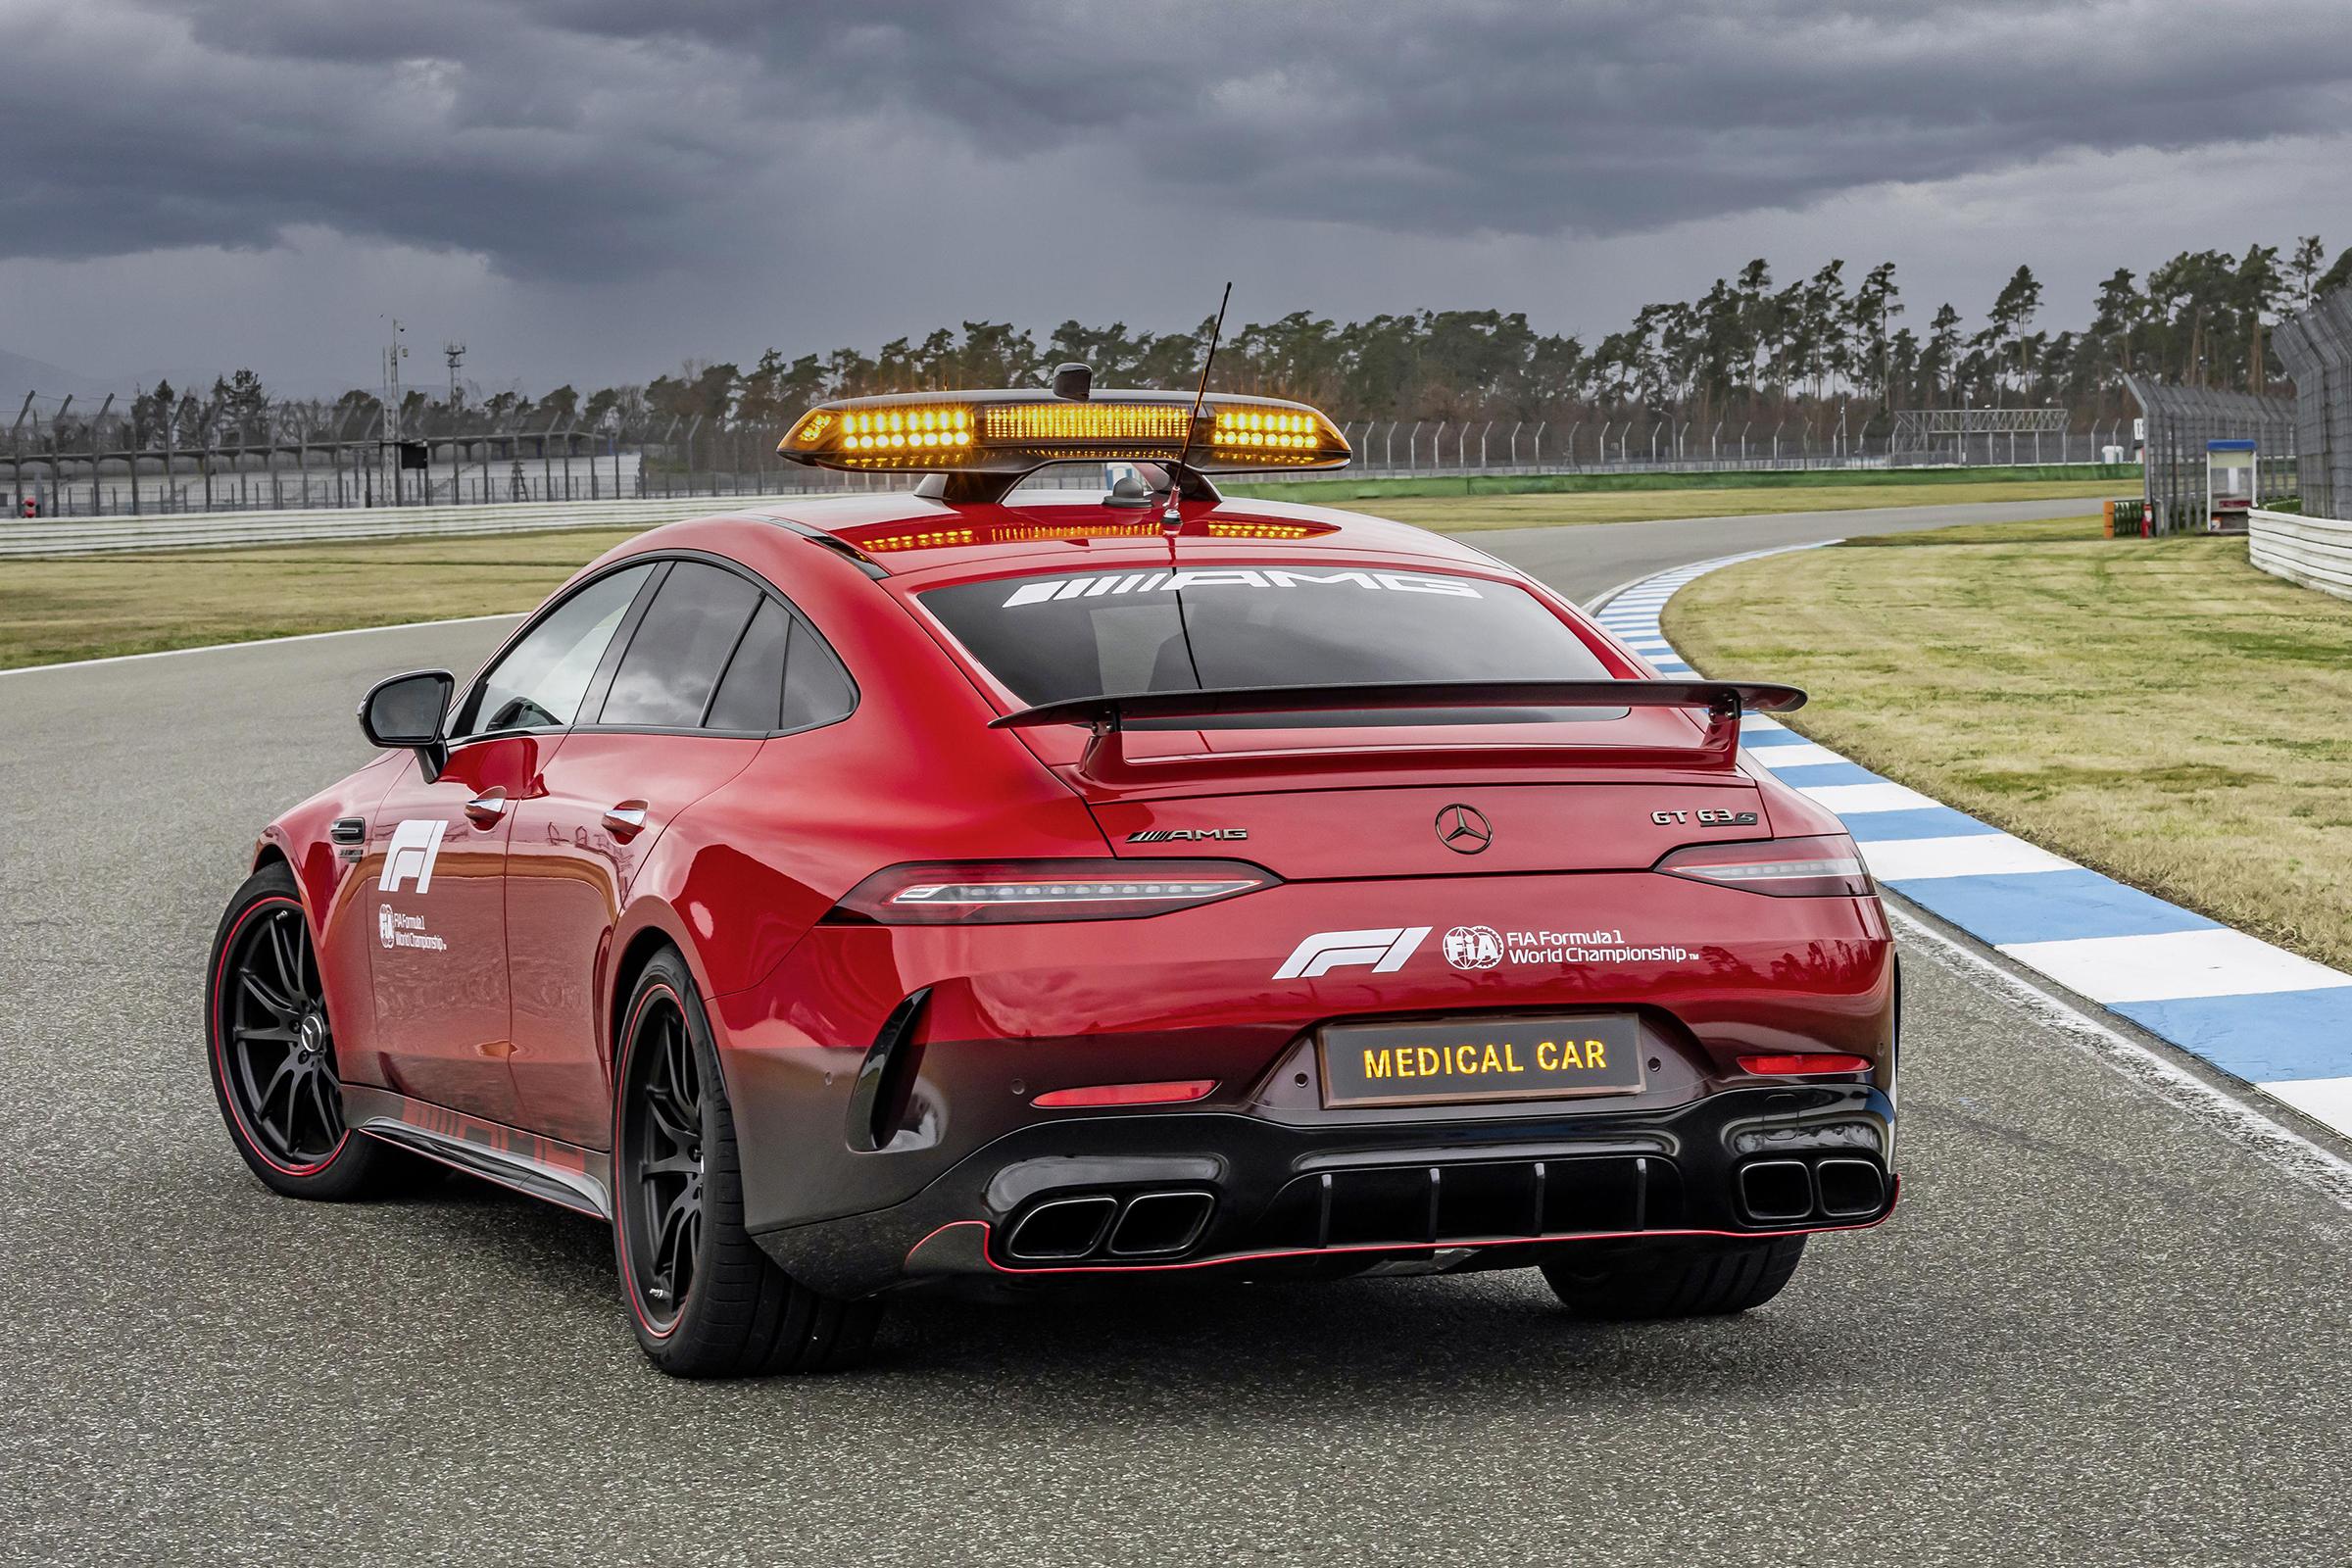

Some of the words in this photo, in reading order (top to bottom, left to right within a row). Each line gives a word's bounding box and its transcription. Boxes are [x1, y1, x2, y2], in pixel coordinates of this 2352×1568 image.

[1162, 569, 1484, 599] AMG
[1650, 810, 1688, 825] GT
[1165, 828, 1249, 842] AMG
[378, 819, 449, 894] F1
[1505, 931, 1539, 947] FIA
[1539, 929, 1612, 946] Formula
[1612, 929, 1626, 944] 1
[1271, 926, 1434, 980] F1
[1508, 947, 1563, 964] World
[1363, 1043, 1524, 1080] MEDICAL
[1536, 1039, 1607, 1072] CAR
